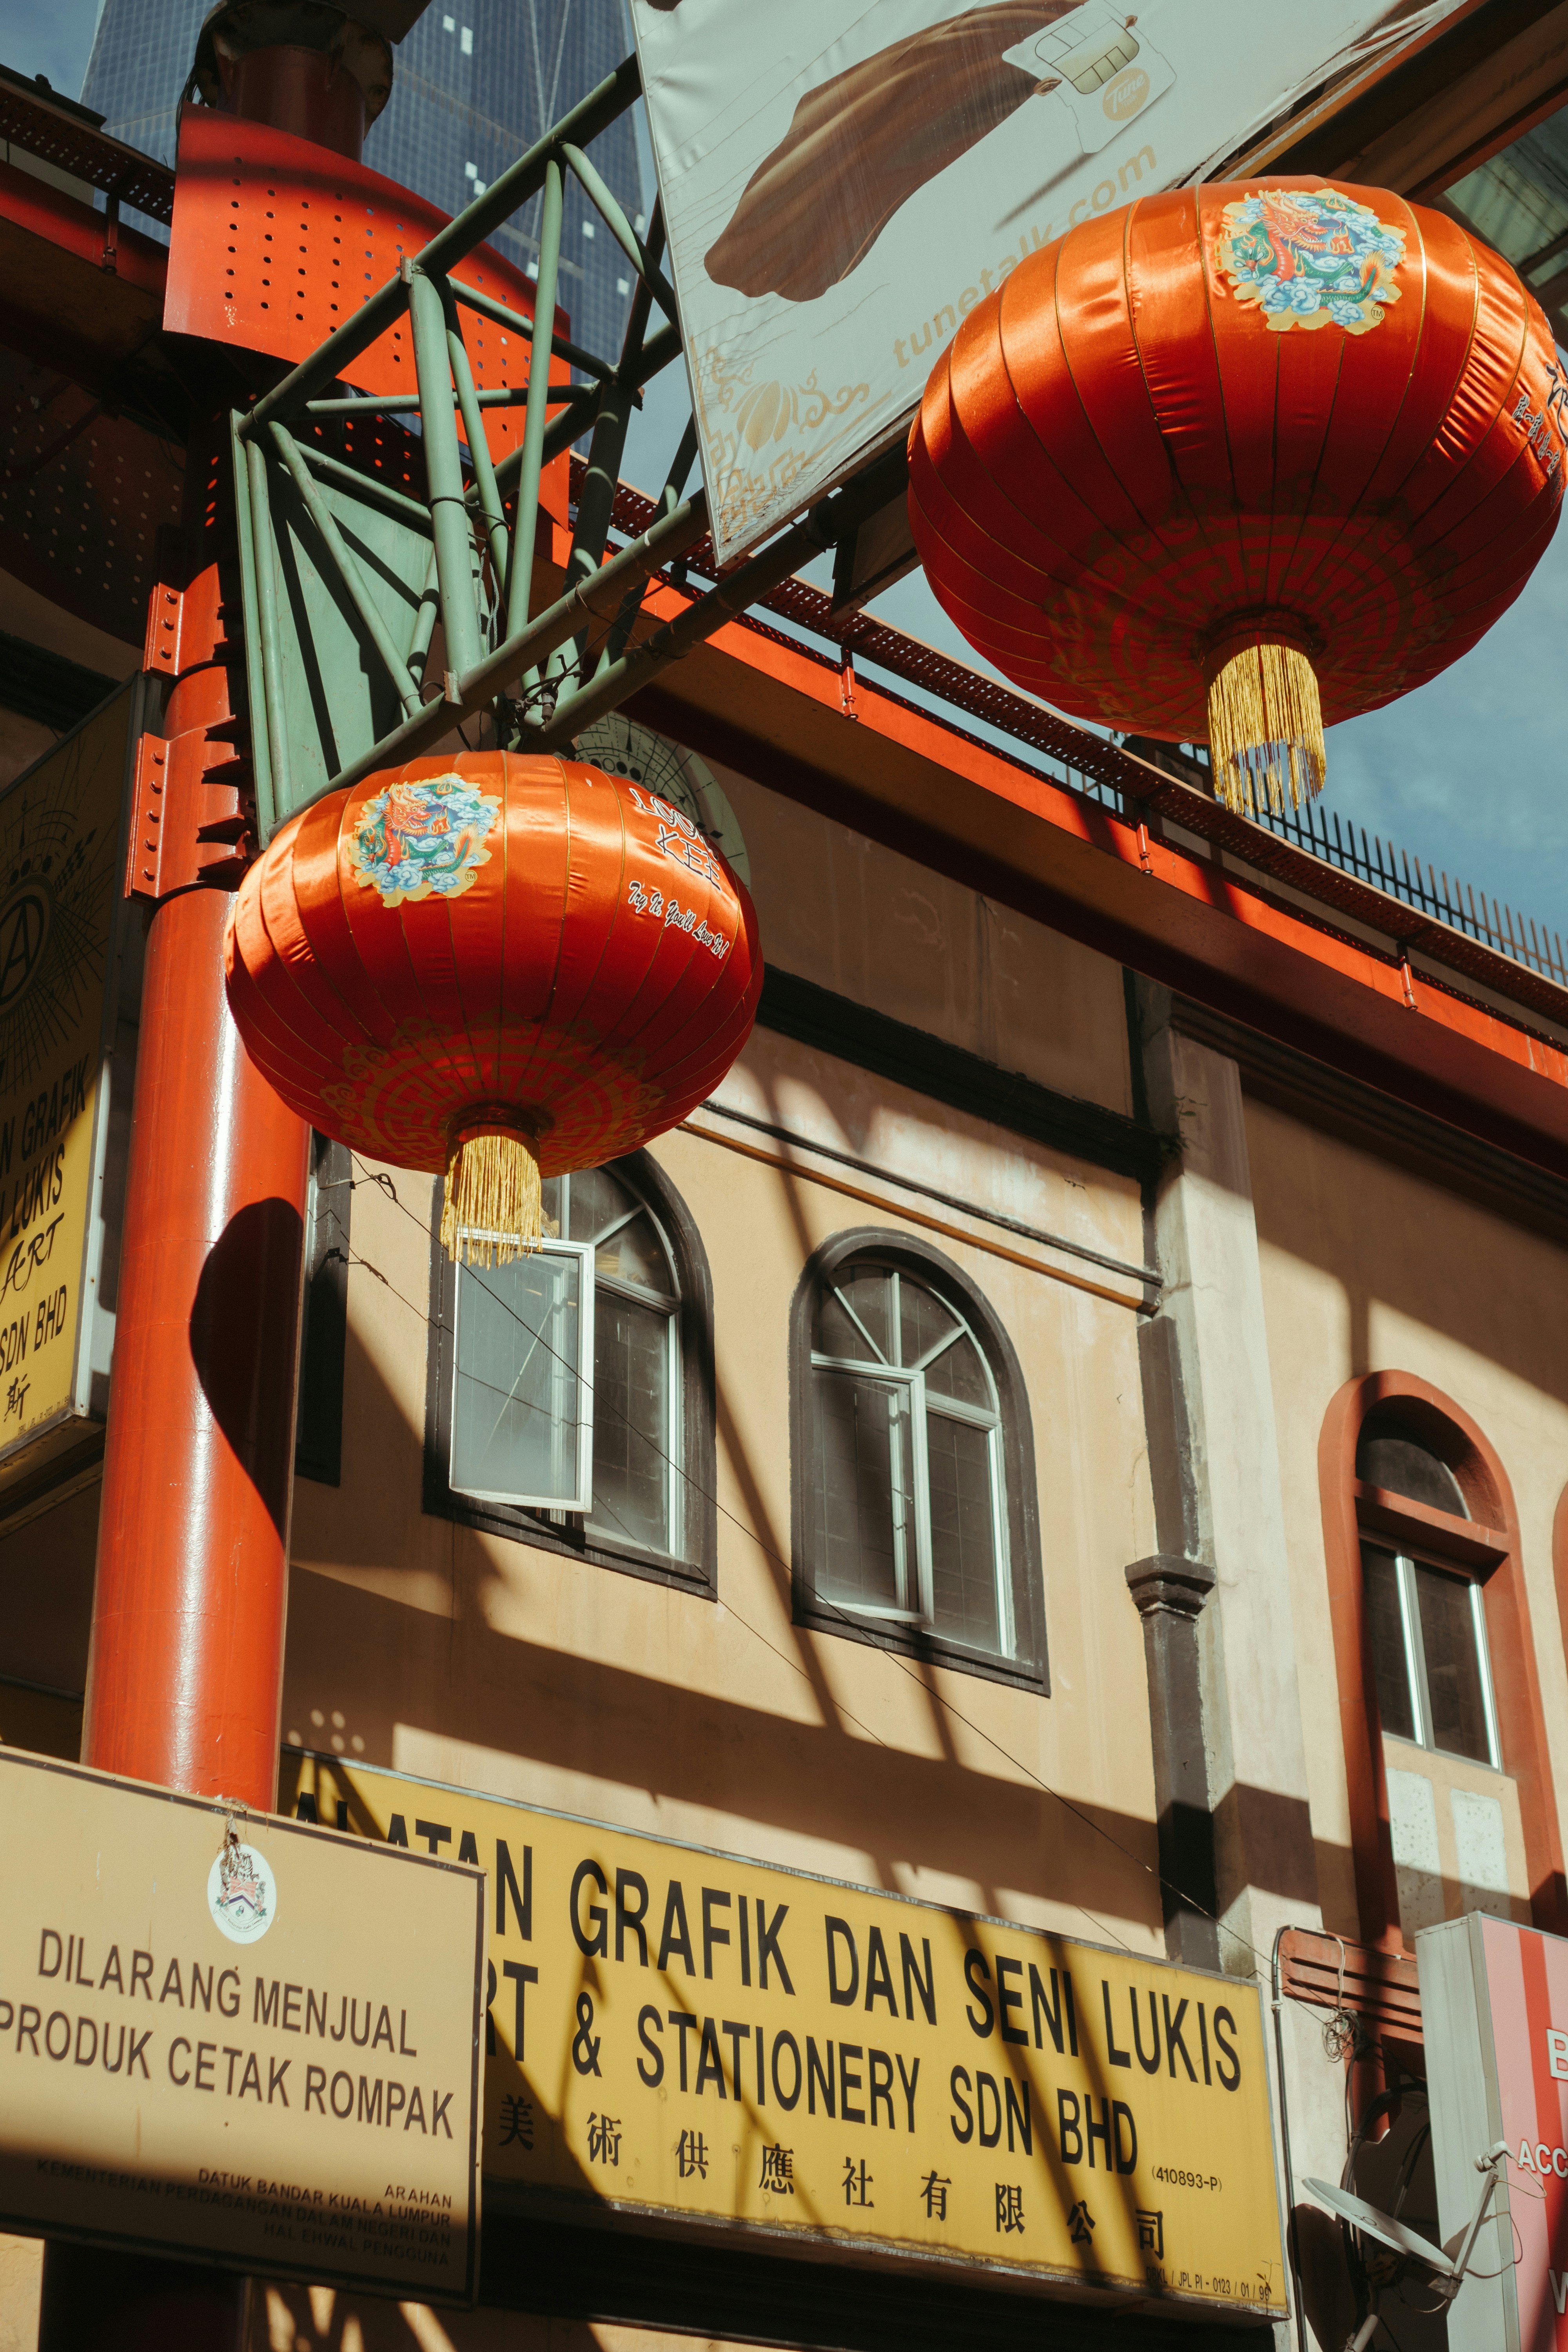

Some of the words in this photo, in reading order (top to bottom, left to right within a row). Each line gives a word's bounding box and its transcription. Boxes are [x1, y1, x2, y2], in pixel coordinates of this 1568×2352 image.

[1105, 74, 1144, 114] Tune
[893, 144, 1157, 368] tunetalkcom
[655, 824, 722, 892] KEE
[628, 880, 648, 913] Try
[664, 900, 696, 932] You'll
[692, 920, 714, 946] Love
[711, 933, 729, 959] It!
[22, 1053, 89, 1161] GRAFIK
[10, 1143, 65, 1240] LUKIS
[34, 1284, 67, 1352] BHD
[37, 1929, 241, 2018] DILARANG
[253, 1976, 417, 2058] MENJUAL
[569, 1858, 795, 1995] GRAFIK
[825, 1915, 937, 2025] DAN
[963, 1948, 1079, 2057] SENI
[1101, 1980, 1241, 2092] LUKIS
[0, 2000, 154, 2079] PRODUK
[168, 2037, 292, 2107] CETAK
[305, 2064, 454, 2140] ROMPAK
[572, 1992, 602, 2078] &
[636, 2004, 920, 2134] STATIONERY
[950, 2065, 1033, 2156] SDN
[1057, 2088, 1138, 2176] BHD
[36, 2159, 160, 2196] KEMENTERIAN
[165, 2183, 292, 2221] PERDAGANGAN
[296, 2207, 355, 2231] DALAM
[358, 2218, 416, 2242] NEGERI
[418, 2226, 452, 2249] DAN
[198, 2169, 251, 2192] DATUK
[258, 2176, 323, 2206] BANDAR
[329, 2192, 383, 2216] KUALA
[388, 2203, 450, 2228] LUMPUR
[384, 2183, 452, 2209] ARAHAN
[499, 2094, 1164, 2260] 美術供應社有限公司
[1152, 2166, 1222, 2192] (410893-P)
[263, 2223, 297, 2241] HAL
[301, 2230, 357, 2253] EHWAL
[363, 2239, 449, 2267] PENGGUNA
[1178, 2272, 1192, 2288] JPL
[1195, 2274, 1203, 2290] PI
[1213, 2278, 1231, 2294] 0123
[1241, 2283, 1250, 2298] 01
[1259, 2285, 1270, 2301] 99
